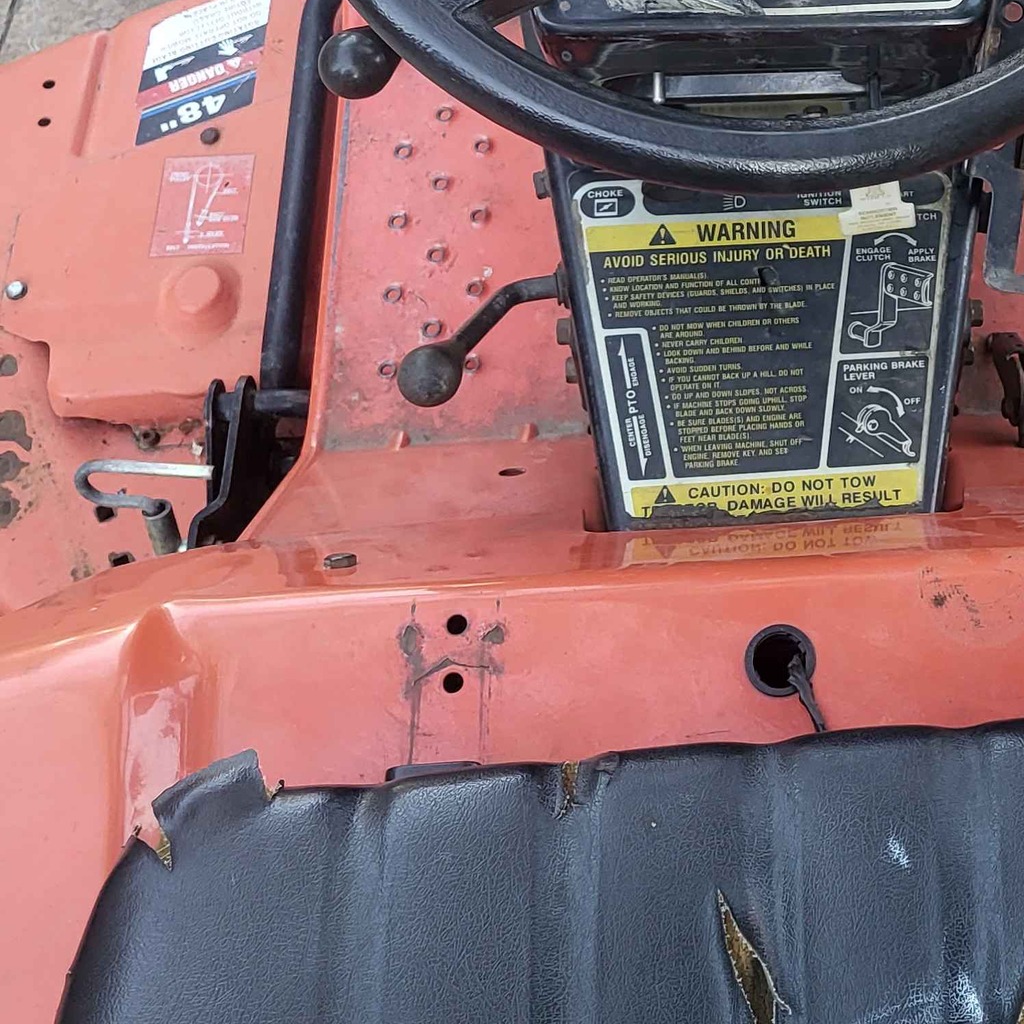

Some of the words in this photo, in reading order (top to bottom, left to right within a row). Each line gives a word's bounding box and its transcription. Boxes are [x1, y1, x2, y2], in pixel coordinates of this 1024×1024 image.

[168, 66, 226, 93] DANGER
[160, 94, 226, 132] 48"
[586, 189, 624, 199] CHOKE
[804, 198, 842, 206] SWITCH
[696, 220, 796, 242] WARNING
[856, 246, 892, 254] ENGAGE
[908, 248, 935, 256] APPLY
[603, 254, 644, 269] AVOID
[650, 252, 707, 266] SERIOUS
[713, 248, 760, 264] INJURY
[765, 247, 784, 261] OR
[789, 245, 831, 260] DEATH
[856, 254, 892, 262] CLUTCH
[630, 293, 656, 301] SAFETY
[752, 286, 766, 294] AND
[814, 282, 836, 290] PLACE
[632, 283, 664, 292] LOCATION
[664, 282, 679, 290] AND
[681, 280, 714, 288] FUNCTION
[615, 310, 643, 318] REMOVE
[644, 308, 673, 316] OBJECTS
[694, 305, 716, 313] COULD
[729, 303, 757, 311] THROWN
[759, 302, 768, 310] BY
[687, 322, 704, 330] MOW
[706, 320, 726, 328] WHEN
[728, 319, 760, 327] CHILDREN
[774, 317, 800, 325] OTHERS
[662, 340, 684, 348] NEVER
[663, 349, 680, 357] LOOK
[683, 348, 704, 356] DOWN
[748, 344, 773, 352] BEFORE
[627, 356, 639, 387] ENGAGE
[667, 366, 688, 374] AVOID
[689, 364, 717, 373] SUDDEN
[843, 362, 888, 372] PARKING
[891, 360, 925, 370] BRAKE
[692, 374, 720, 382] CANNOT
[790, 368, 804, 376] NOT
[844, 372, 875, 381] LEVER
[670, 383, 699, 391] OPERATE
[684, 392, 694, 400] UP
[696, 391, 709, 399] AND
[712, 390, 733, 398] DOWN
[626, 390, 638, 414] PTO
[682, 400, 712, 409] MACHINE
[715, 399, 736, 407] STOPS
[738, 398, 760, 406] GOING
[903, 397, 921, 406] OFF
[675, 410, 696, 418] BLADE
[736, 406, 756, 414] DOWN
[688, 418, 706, 426] SURE
[762, 414, 786, 422] ENGINE
[788, 412, 802, 420] ARE
[625, 418, 636, 448] CENTER
[678, 427, 708, 436] STOPPED
[710, 425, 736, 433] BEFORE
[738, 423, 768, 431] PLACING
[794, 420, 805, 428] OR
[638, 414, 652, 456] DISENGAGE
[698, 434, 716, 442] NEAR
[680, 444, 702, 453] WHEN
[704, 443, 733, 451] LEAVING
[770, 439, 788, 447] SHUT
[790, 438, 802, 446] OFF
[712, 450, 740, 459] REMOVE
[758, 448, 773, 456] AND
[685, 460, 714, 469] PARKING
[688, 484, 765, 500] CAUTION:
[771, 481, 795, 494] DO
[802, 478, 833, 492] NOT
[840, 476, 876, 489] TOW
[727, 496, 796, 512] DAMAGE
[800, 494, 837, 508] WILL
[842, 489, 902, 504] RESULT
